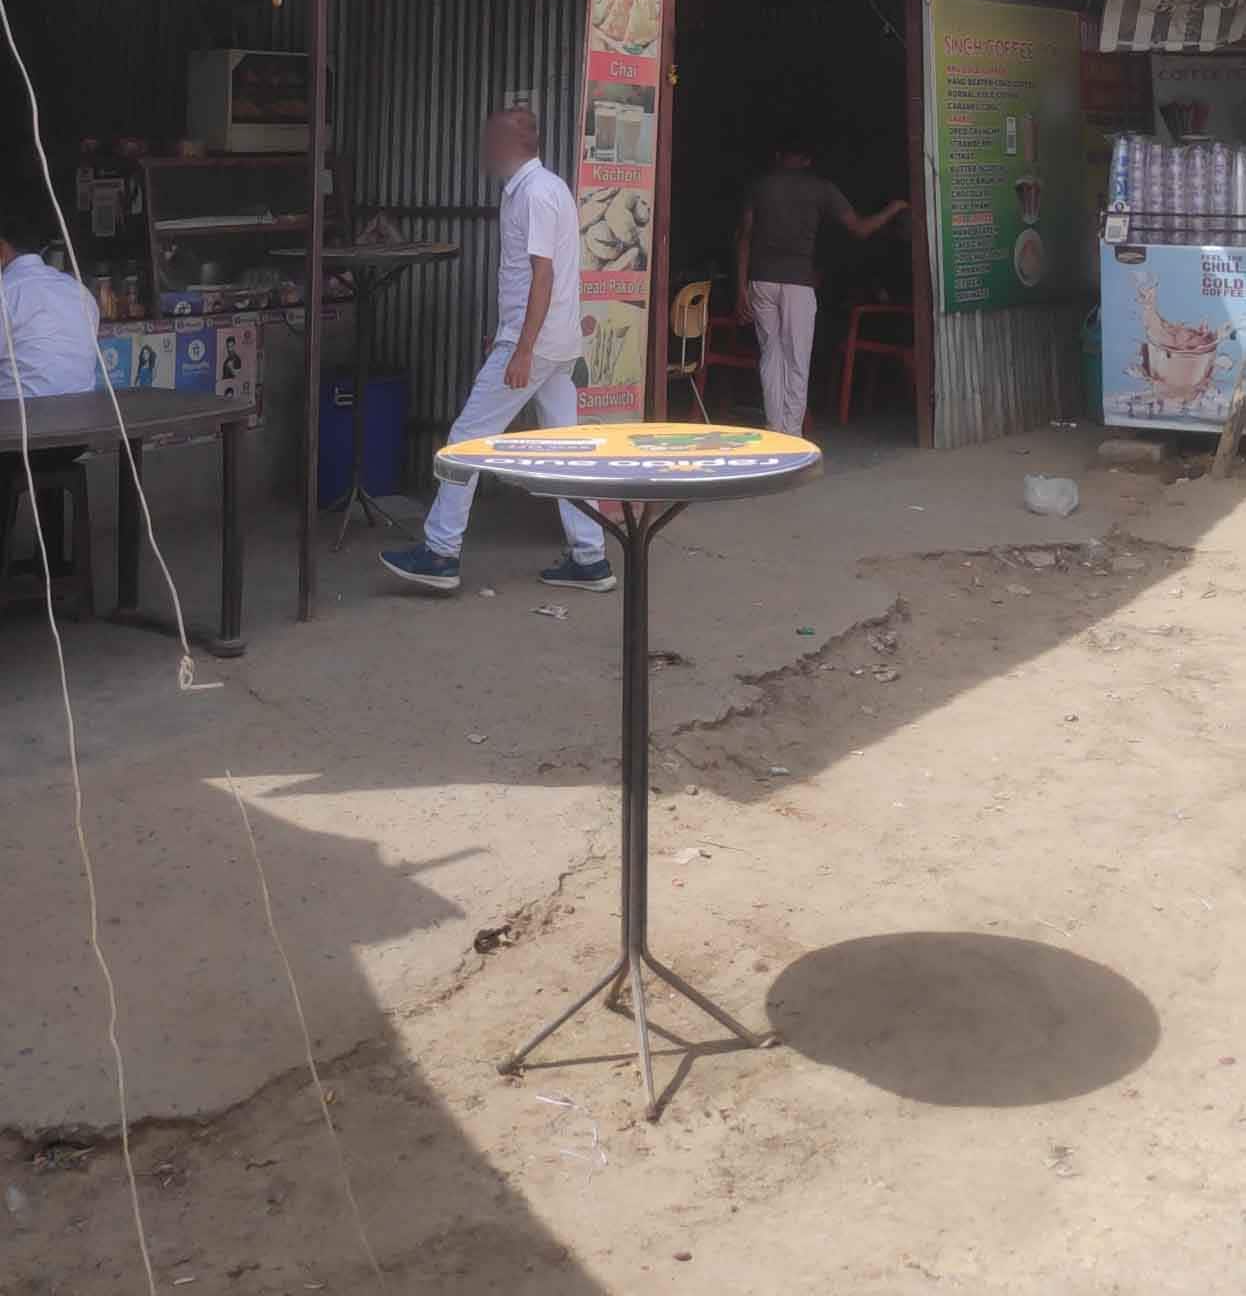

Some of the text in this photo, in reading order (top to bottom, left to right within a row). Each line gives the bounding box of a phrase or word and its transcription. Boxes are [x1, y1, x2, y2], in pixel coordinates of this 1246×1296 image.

[608, 60, 638, 79] Chai
[592, 164, 641, 184] Kachori
[1202, 261, 1245, 273] CHILL
[1202, 277, 1244, 289] COLD
[484, 456, 780, 470] rapido auto
